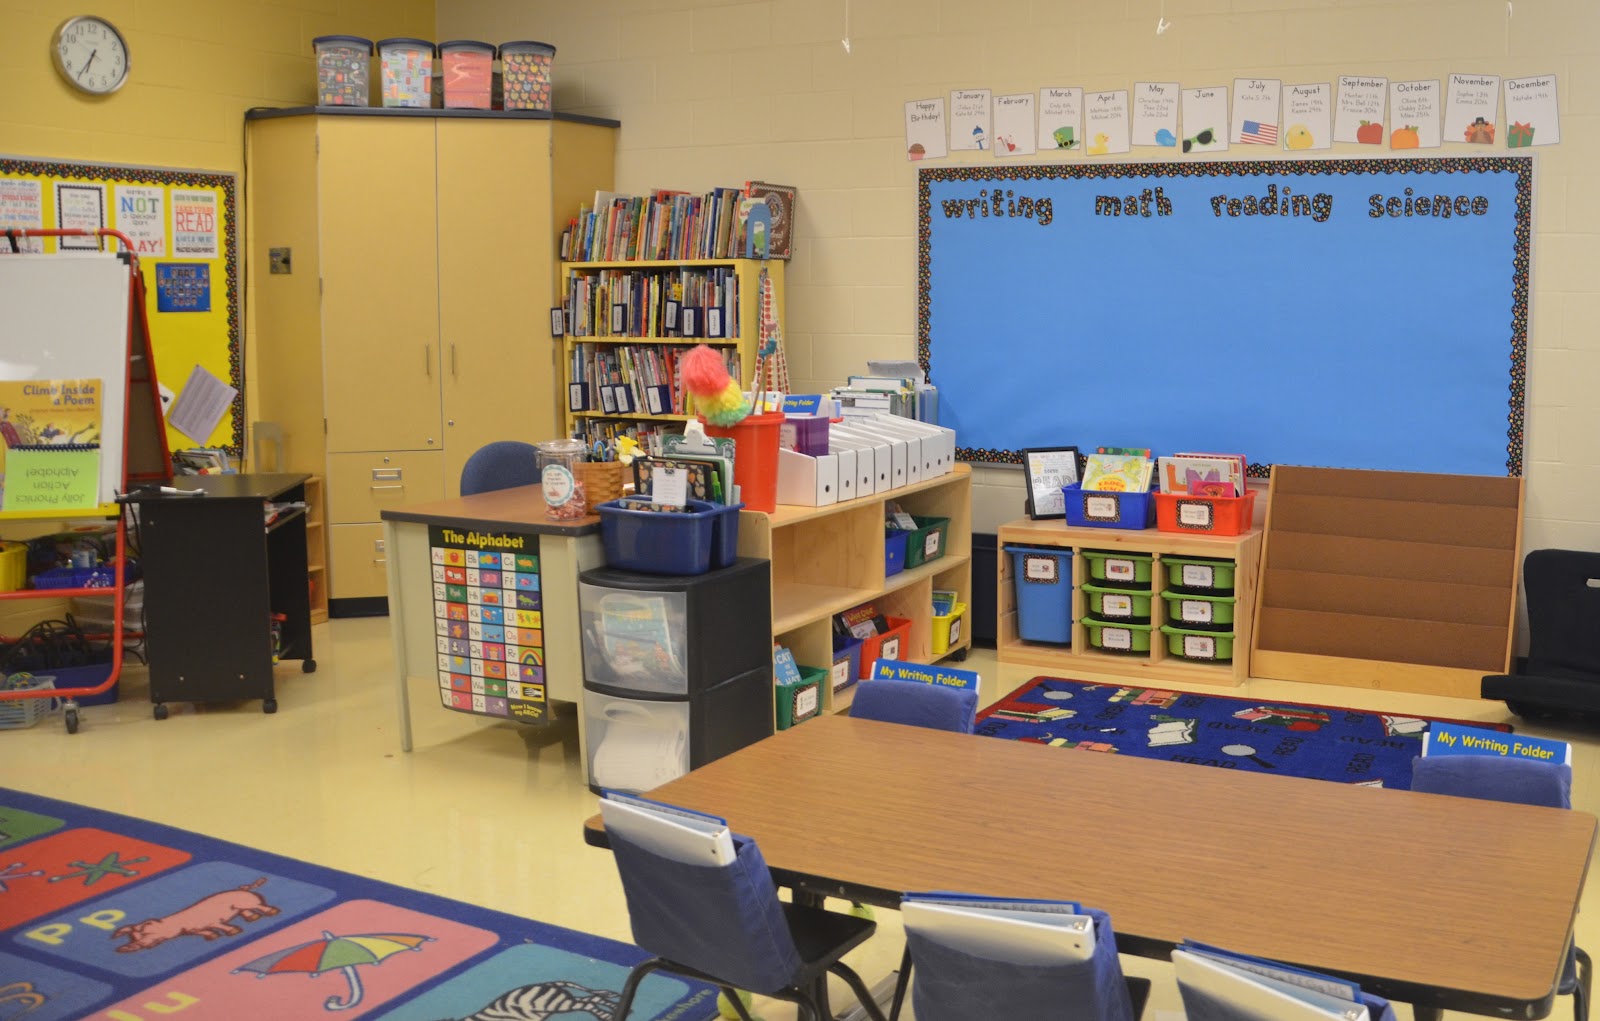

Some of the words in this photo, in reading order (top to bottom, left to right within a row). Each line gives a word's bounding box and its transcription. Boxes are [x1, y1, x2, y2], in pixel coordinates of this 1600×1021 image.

[1248, 80, 1266, 92] July
[1342, 78, 1384, 89] September
[1454, 76, 1494, 86] November
[1509, 80, 1550, 90] December
[1148, 84, 1164, 94] May
[1292, 87, 1320, 98] August
[1397, 84, 1431, 93] October
[957, 92, 984, 102] January
[1050, 90, 1072, 98] March
[1097, 94, 1116, 104] April
[1194, 90, 1214, 99] June
[916, 102, 936, 112] Happy
[998, 98, 1030, 108] February
[911, 113, 940, 123] Birthday!
[121, 196, 159, 213] NOT
[942, 189, 1053, 225] writing
[1094, 186, 1172, 218] math
[1210, 184, 1332, 222] reading
[1368, 187, 1488, 218] science
[176, 212, 214, 232] READ
[23, 384, 57, 396] Climb
[61, 384, 95, 394] Inside
[53, 397, 60, 405] a
[63, 395, 95, 405] Poem
[442, 529, 464, 544] The
[467, 532, 524, 549] Alphabet
[776, 652, 791, 664] CAT
[880, 665, 894, 678] My
[899, 667, 933, 685] Writing
[936, 673, 967, 687] Folder
[1437, 731, 1458, 750] My
[1462, 735, 1511, 756] Writing
[1514, 742, 1555, 760] Folder
